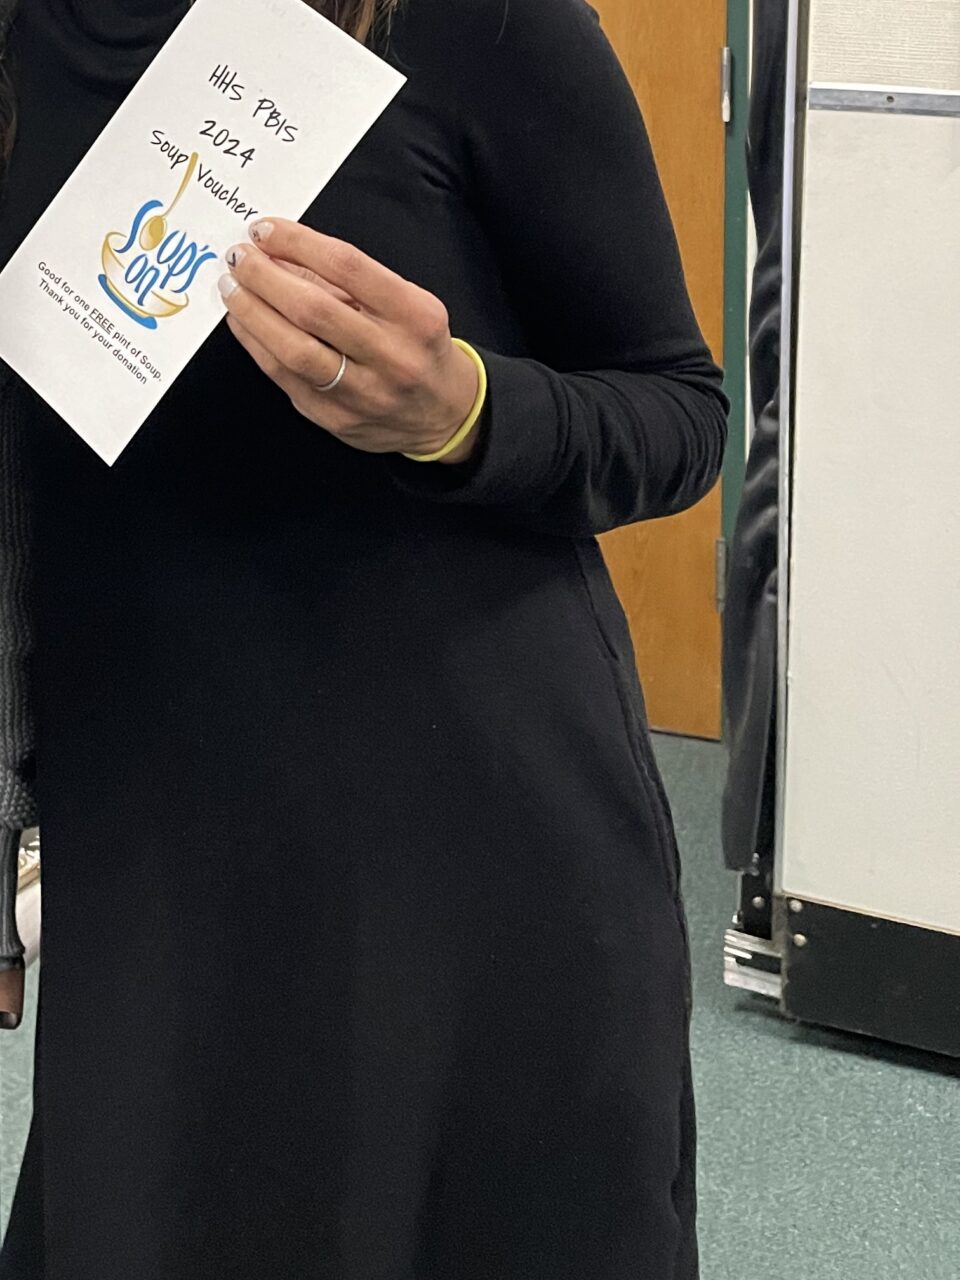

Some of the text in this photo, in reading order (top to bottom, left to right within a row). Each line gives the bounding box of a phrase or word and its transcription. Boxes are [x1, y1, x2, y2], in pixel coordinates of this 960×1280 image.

[199, 120, 256, 168] 2024
[208, 64, 298, 142] HHS PBIS
[150, 130, 258, 221] Soup Voucher
[38, 261, 162, 382] Good for one FREE pint of Soup.
[39, 277, 147, 384] Thank you for your donation
